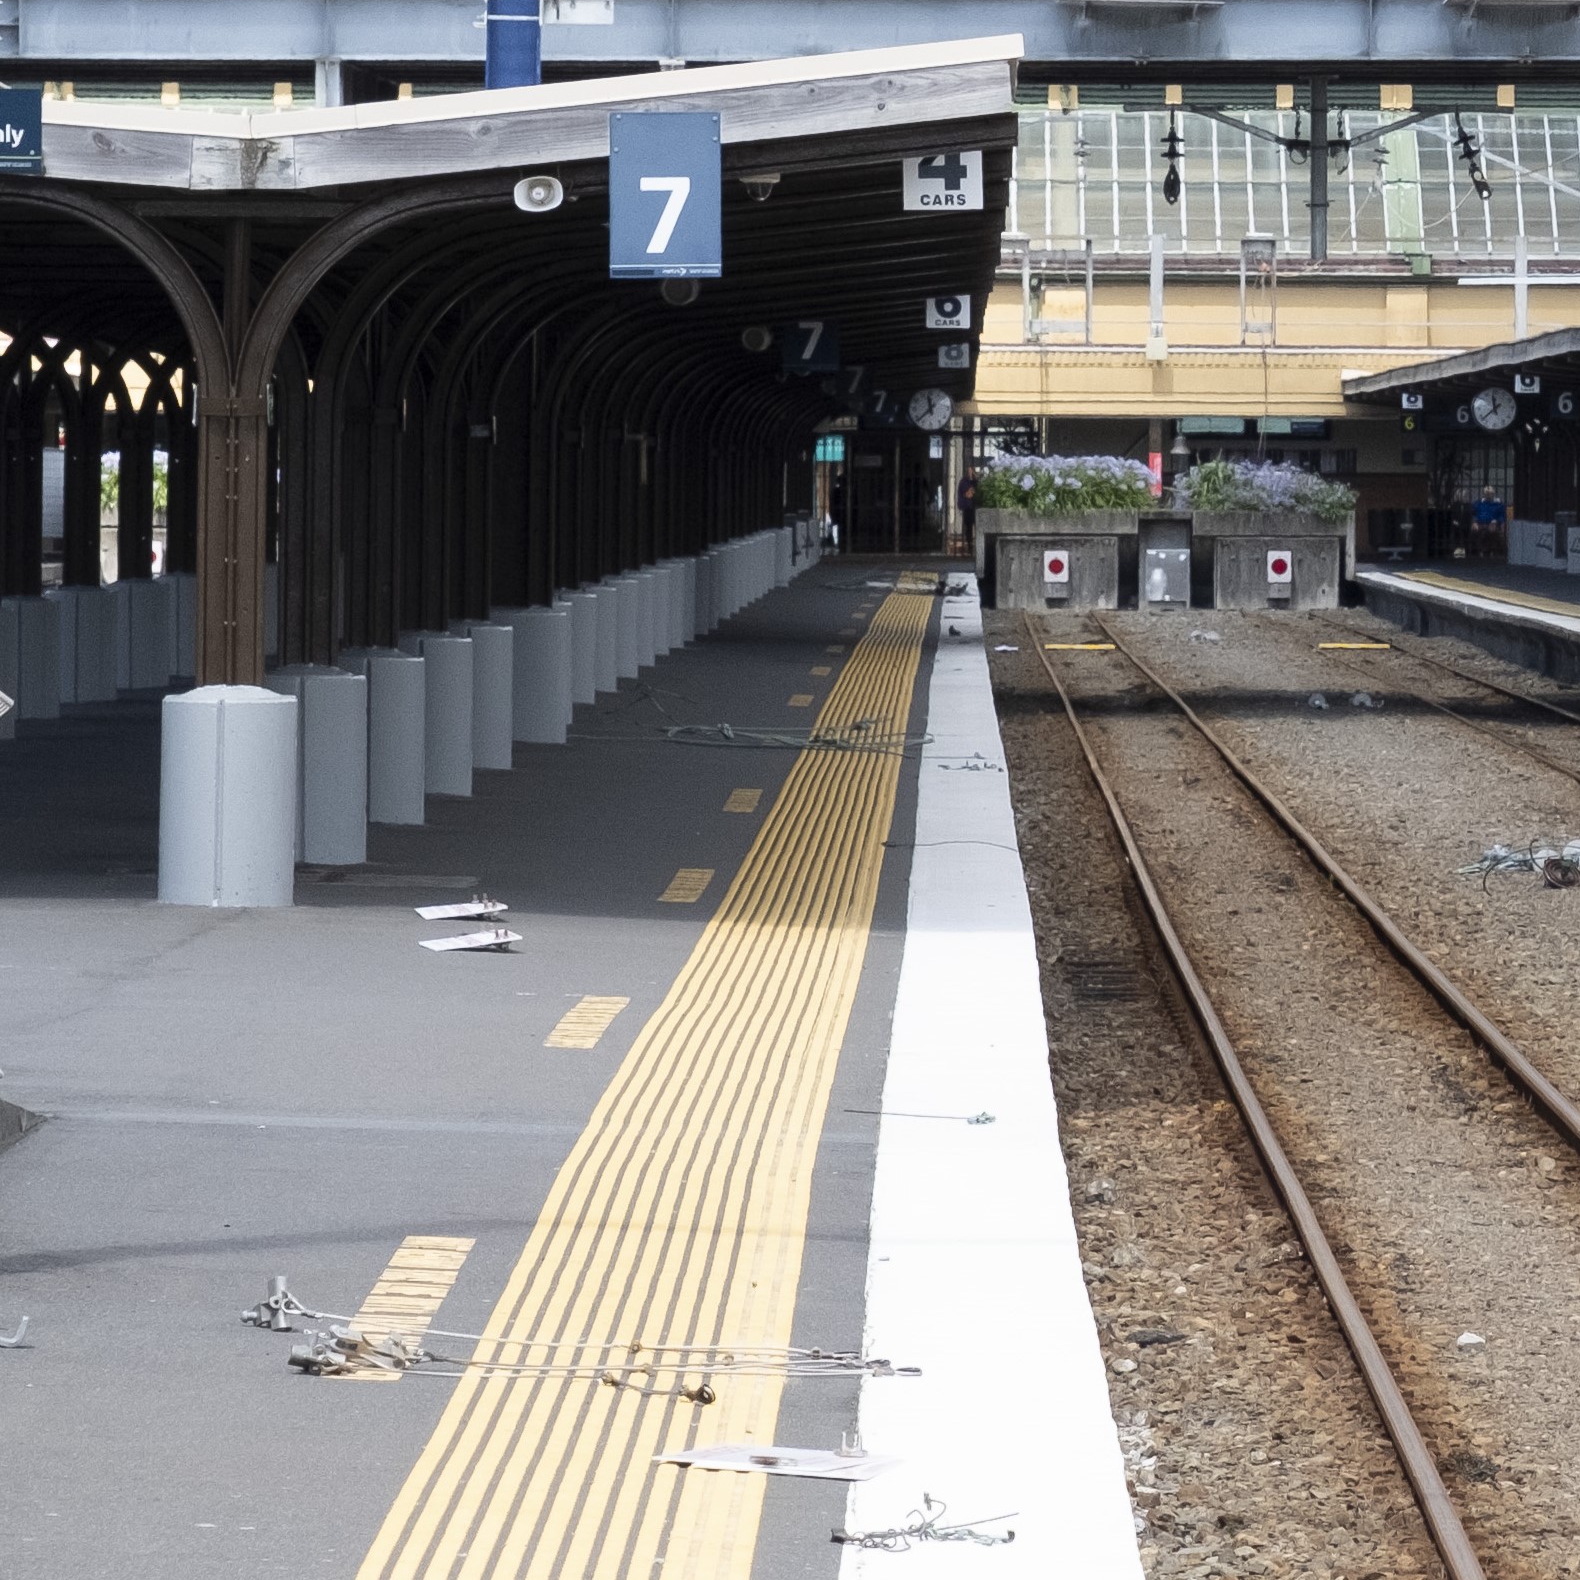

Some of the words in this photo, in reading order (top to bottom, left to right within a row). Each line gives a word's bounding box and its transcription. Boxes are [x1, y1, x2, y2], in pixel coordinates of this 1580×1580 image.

[918, 155, 967, 191] 4
[920, 194, 966, 206] CARS
[640, 177, 690, 253] 7
[799, 322, 823, 360] 7
[846, 366, 863, 393] 7
[873, 390, 886, 412] 7
[1558, 392, 1573, 414] 6
[1405, 415, 1414, 430] 6
[1456, 405, 1469, 423] 6
